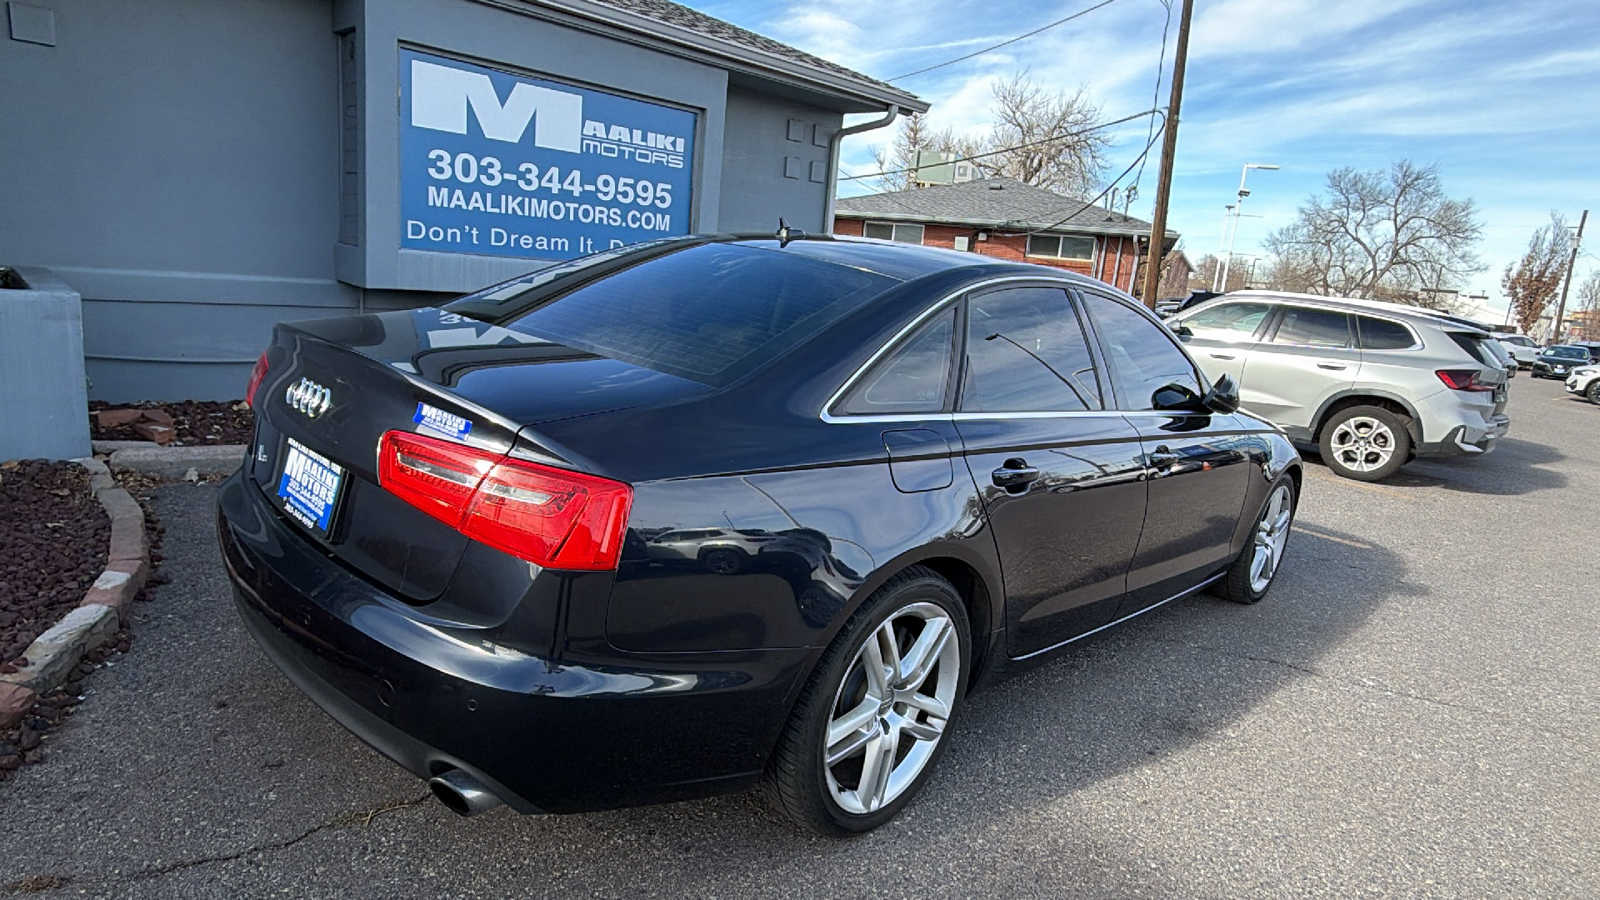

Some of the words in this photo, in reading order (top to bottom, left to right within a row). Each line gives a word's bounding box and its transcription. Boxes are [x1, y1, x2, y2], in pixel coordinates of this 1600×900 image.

[582, 139, 684, 169] MOTORS
[427, 149, 672, 209] 303-344-9595
[427, 185, 671, 232] MAALIKIMOTORS.COM
[406, 219, 479, 245] Don't
[490, 227, 569, 252] Dream
[580, 236, 600, 254] It.
